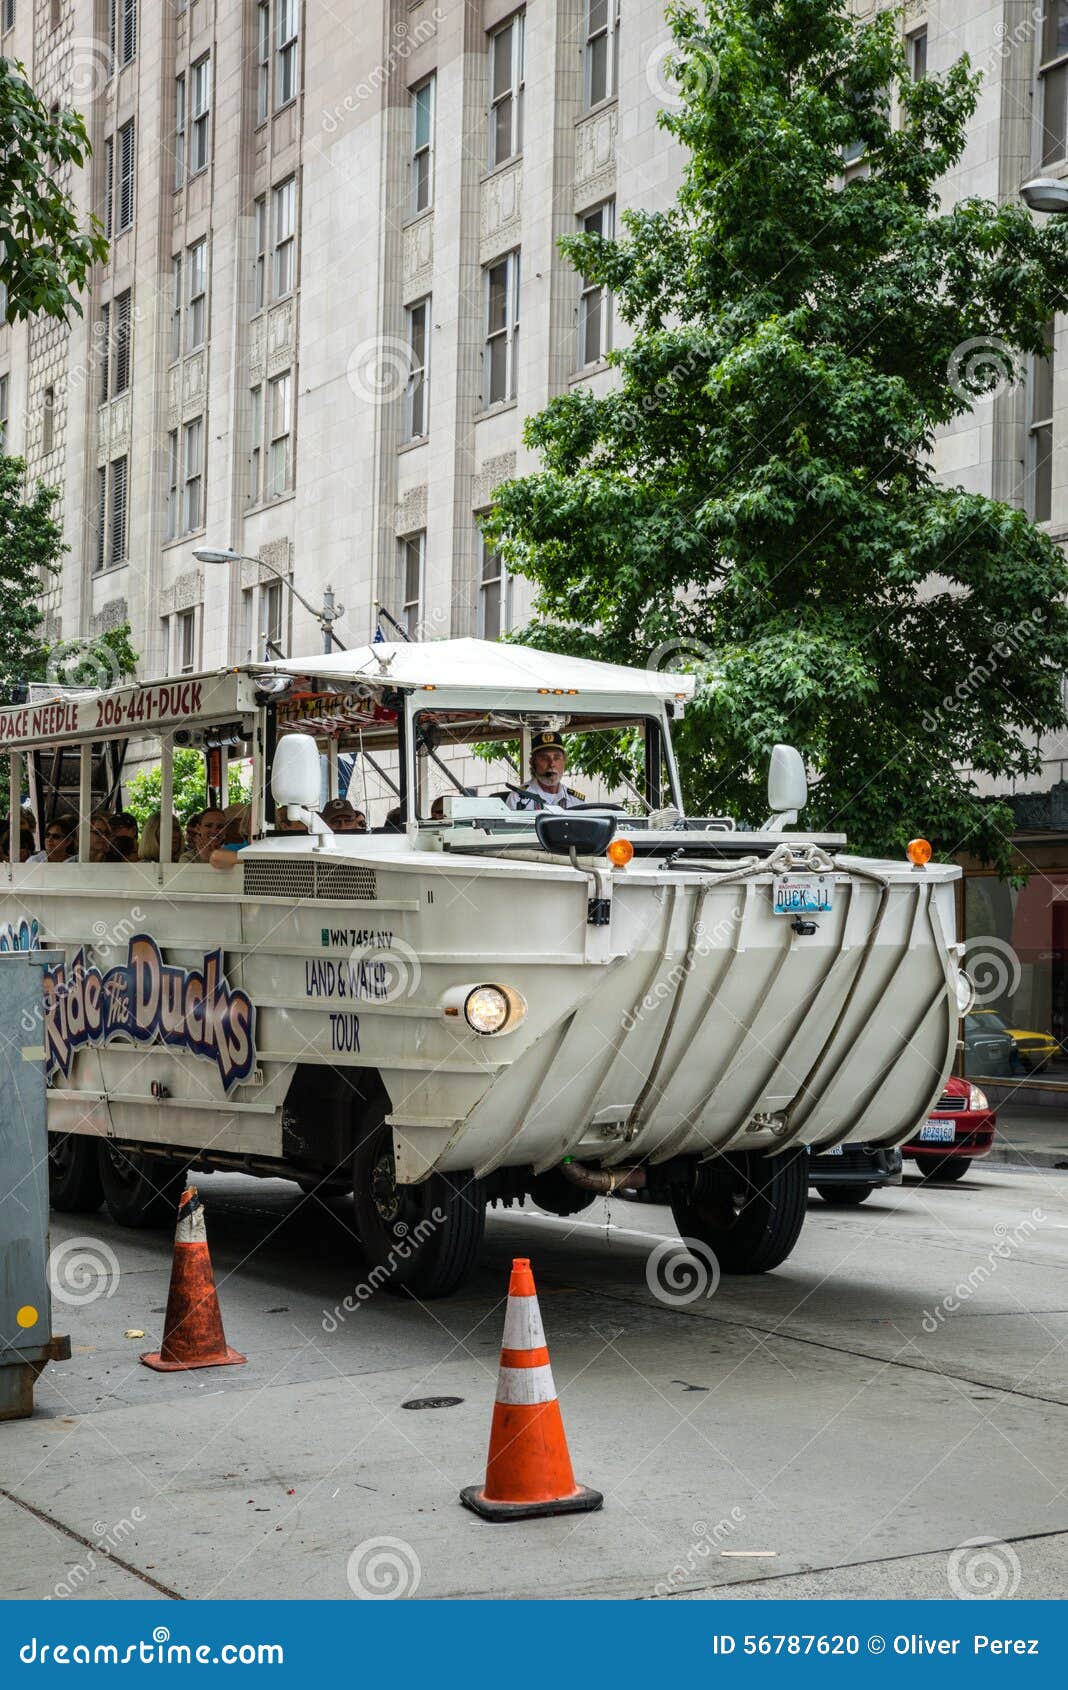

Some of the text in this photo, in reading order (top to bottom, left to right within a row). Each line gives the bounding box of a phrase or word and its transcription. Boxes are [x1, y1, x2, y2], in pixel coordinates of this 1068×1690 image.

[32, 703, 79, 737] NEEDLE
[95, 681, 203, 729] 206-441-DUCK
[777, 889, 808, 907] DUCK
[330, 929, 348, 947] WN
[305, 959, 388, 1000] LAND & WATER
[130, 936, 251, 1079] Ducks
[329, 1013, 361, 1053] TOUR
